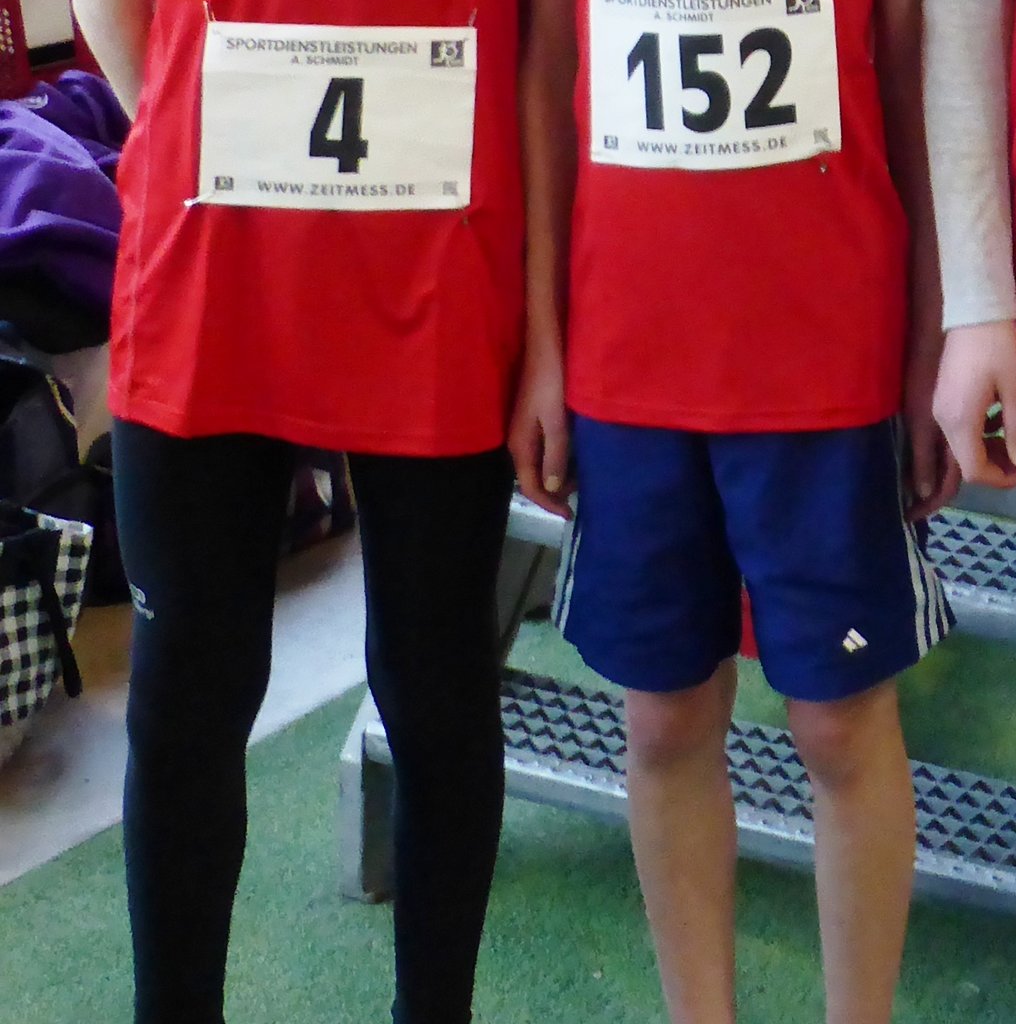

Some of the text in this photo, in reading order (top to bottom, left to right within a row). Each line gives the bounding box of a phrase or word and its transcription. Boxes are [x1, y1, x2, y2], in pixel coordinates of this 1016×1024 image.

[666, 12, 714, 22] SCHMIDT
[226, 37, 418, 54] SPORTDIENSTLEISTUNGEN
[306, 55, 359, 66] SCHMIDT
[626, 26, 797, 133] 152
[309, 77, 369, 174] 4
[637, 135, 788, 155] WWW.ZEITMESS.DE
[257, 180, 416, 196] WWW.ZEITMESS.DE
